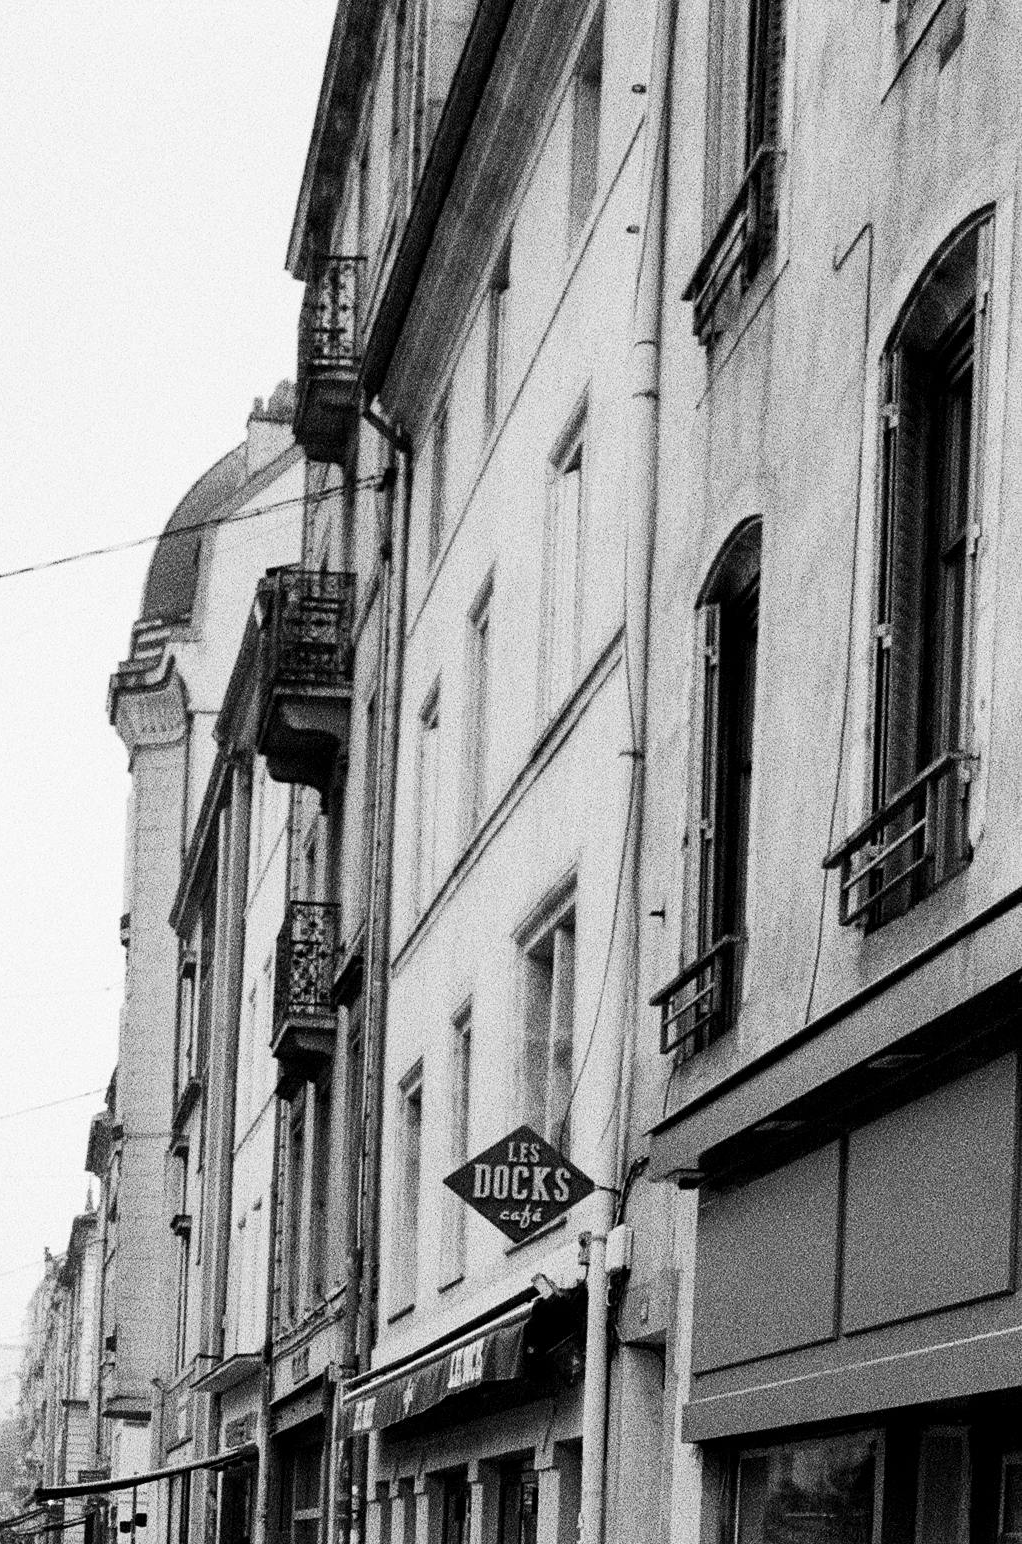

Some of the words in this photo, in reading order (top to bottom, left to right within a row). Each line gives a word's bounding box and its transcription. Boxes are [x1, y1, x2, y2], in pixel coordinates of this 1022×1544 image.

[507, 1141, 541, 1163] LES
[472, 1163, 572, 1202] DOCKS
[498, 1203, 543, 1229] café
